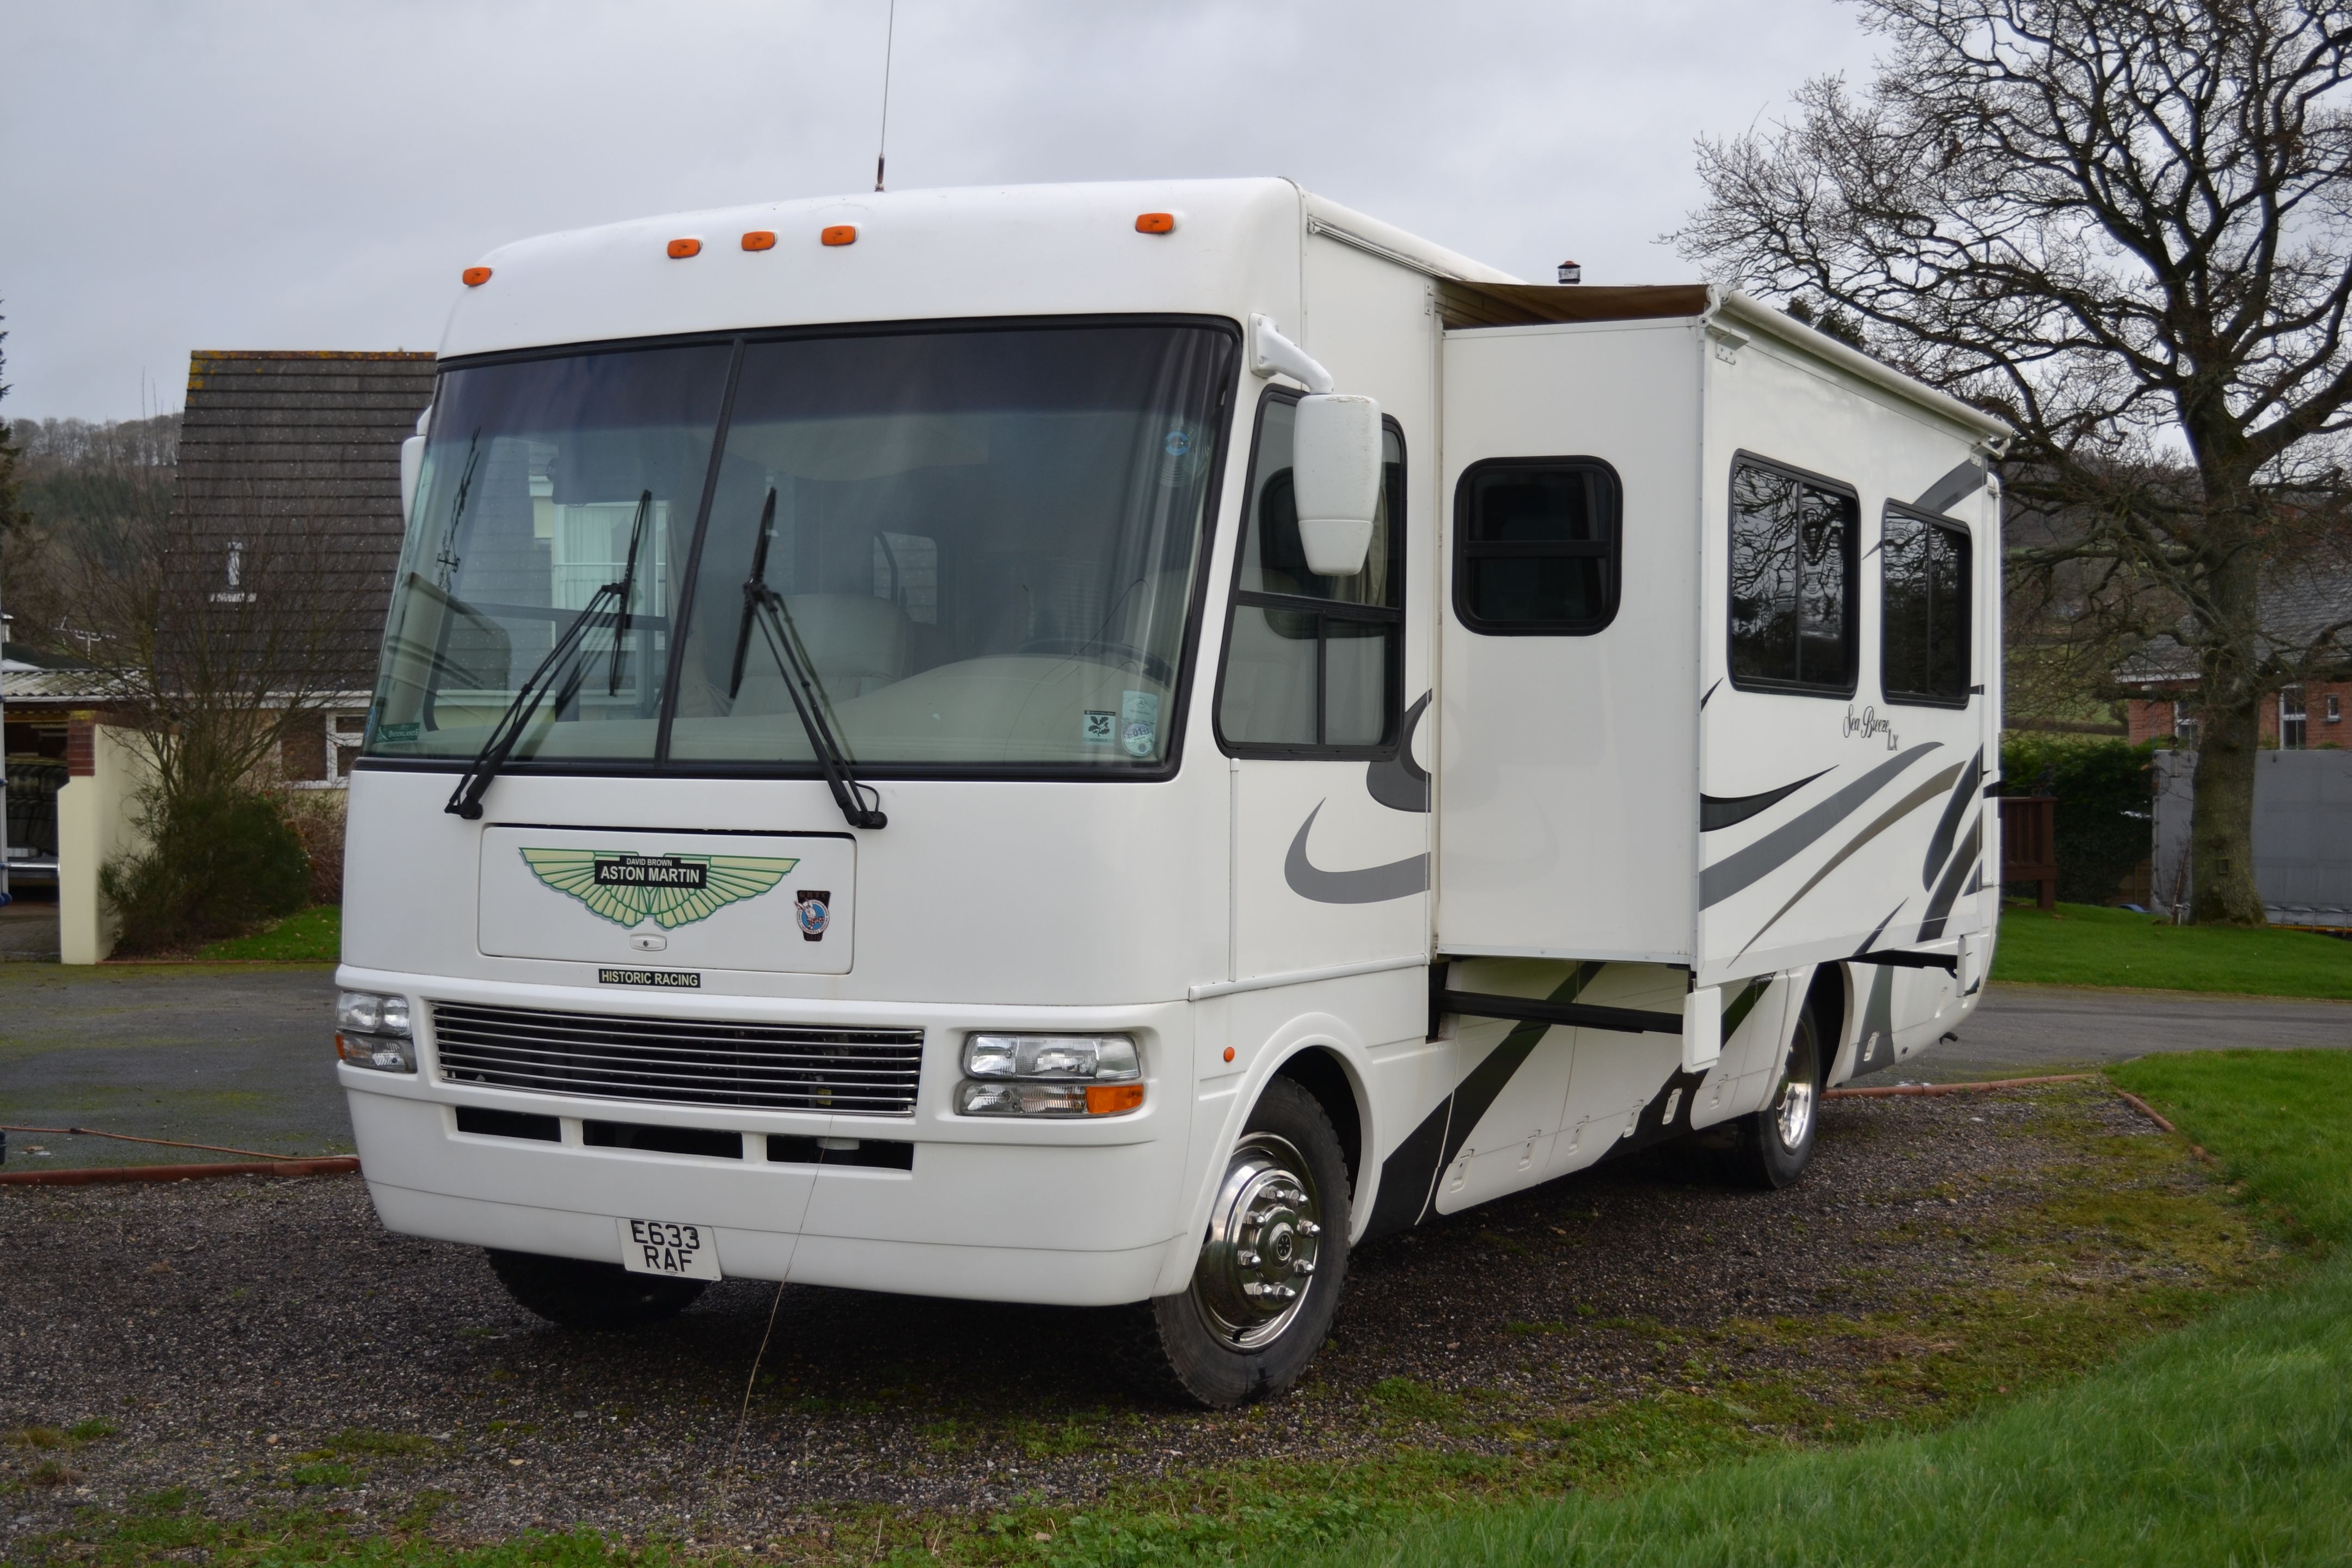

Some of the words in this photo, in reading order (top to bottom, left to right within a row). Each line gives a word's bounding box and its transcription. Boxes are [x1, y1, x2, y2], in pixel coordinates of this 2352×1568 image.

[1843, 703, 1860, 738] Sea
[1860, 706, 1890, 738] Breeze
[626, 857, 646, 866] DAVID
[647, 859, 672, 867] BROWN
[601, 866, 645, 881] ASTON
[648, 867, 700, 883] MARTIN
[602, 970, 651, 984] HISTORIC
[654, 973, 698, 986] RACING
[630, 1220, 700, 1250] E633
[643, 1245, 693, 1272] RAF
